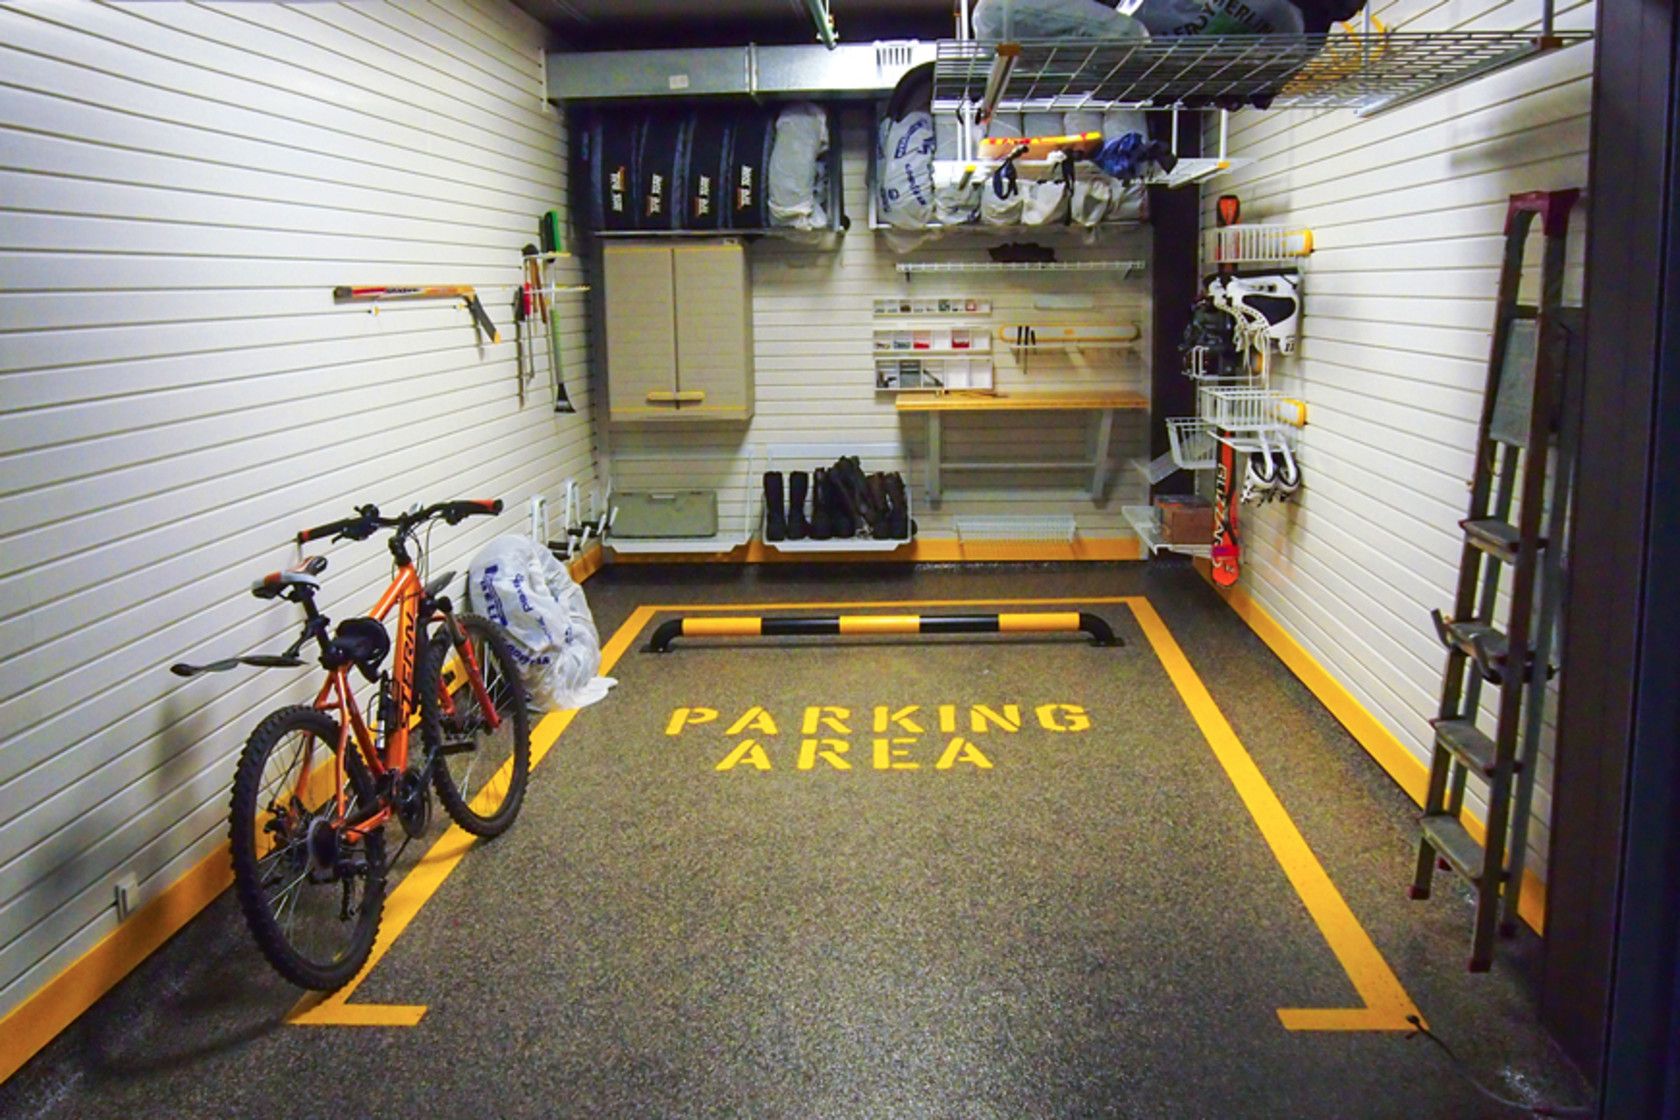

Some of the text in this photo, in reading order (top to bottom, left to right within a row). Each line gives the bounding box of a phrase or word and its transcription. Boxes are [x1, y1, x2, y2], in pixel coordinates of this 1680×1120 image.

[1162, 2, 1216, 36] EROY
[665, 704, 1091, 735] PARKING
[715, 737, 994, 771] AREA
